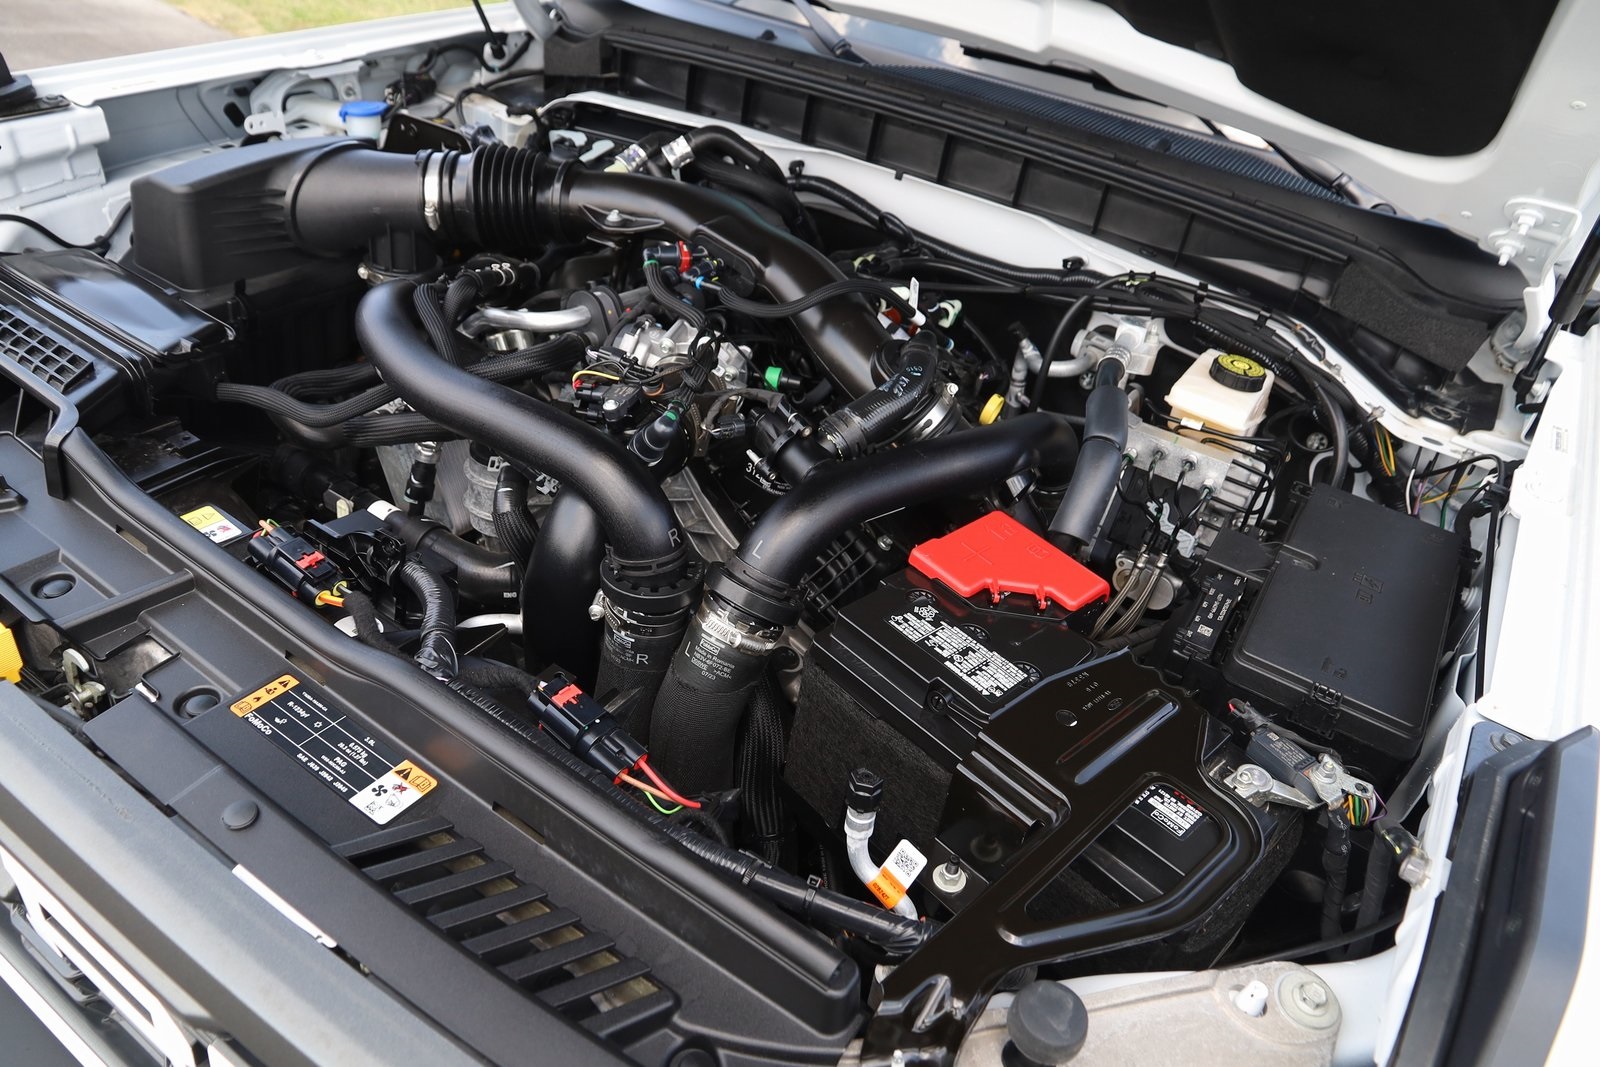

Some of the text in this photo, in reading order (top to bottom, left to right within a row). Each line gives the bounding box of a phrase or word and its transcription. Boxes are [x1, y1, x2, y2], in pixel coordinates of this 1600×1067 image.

[668, 527, 681, 548] R
[752, 539, 763, 560] L
[636, 653, 649, 665] R
[684, 641, 691, 658] L
[243, 712, 273, 735] FoMoCo
[1154, 811, 1184, 834] FoMoCo
